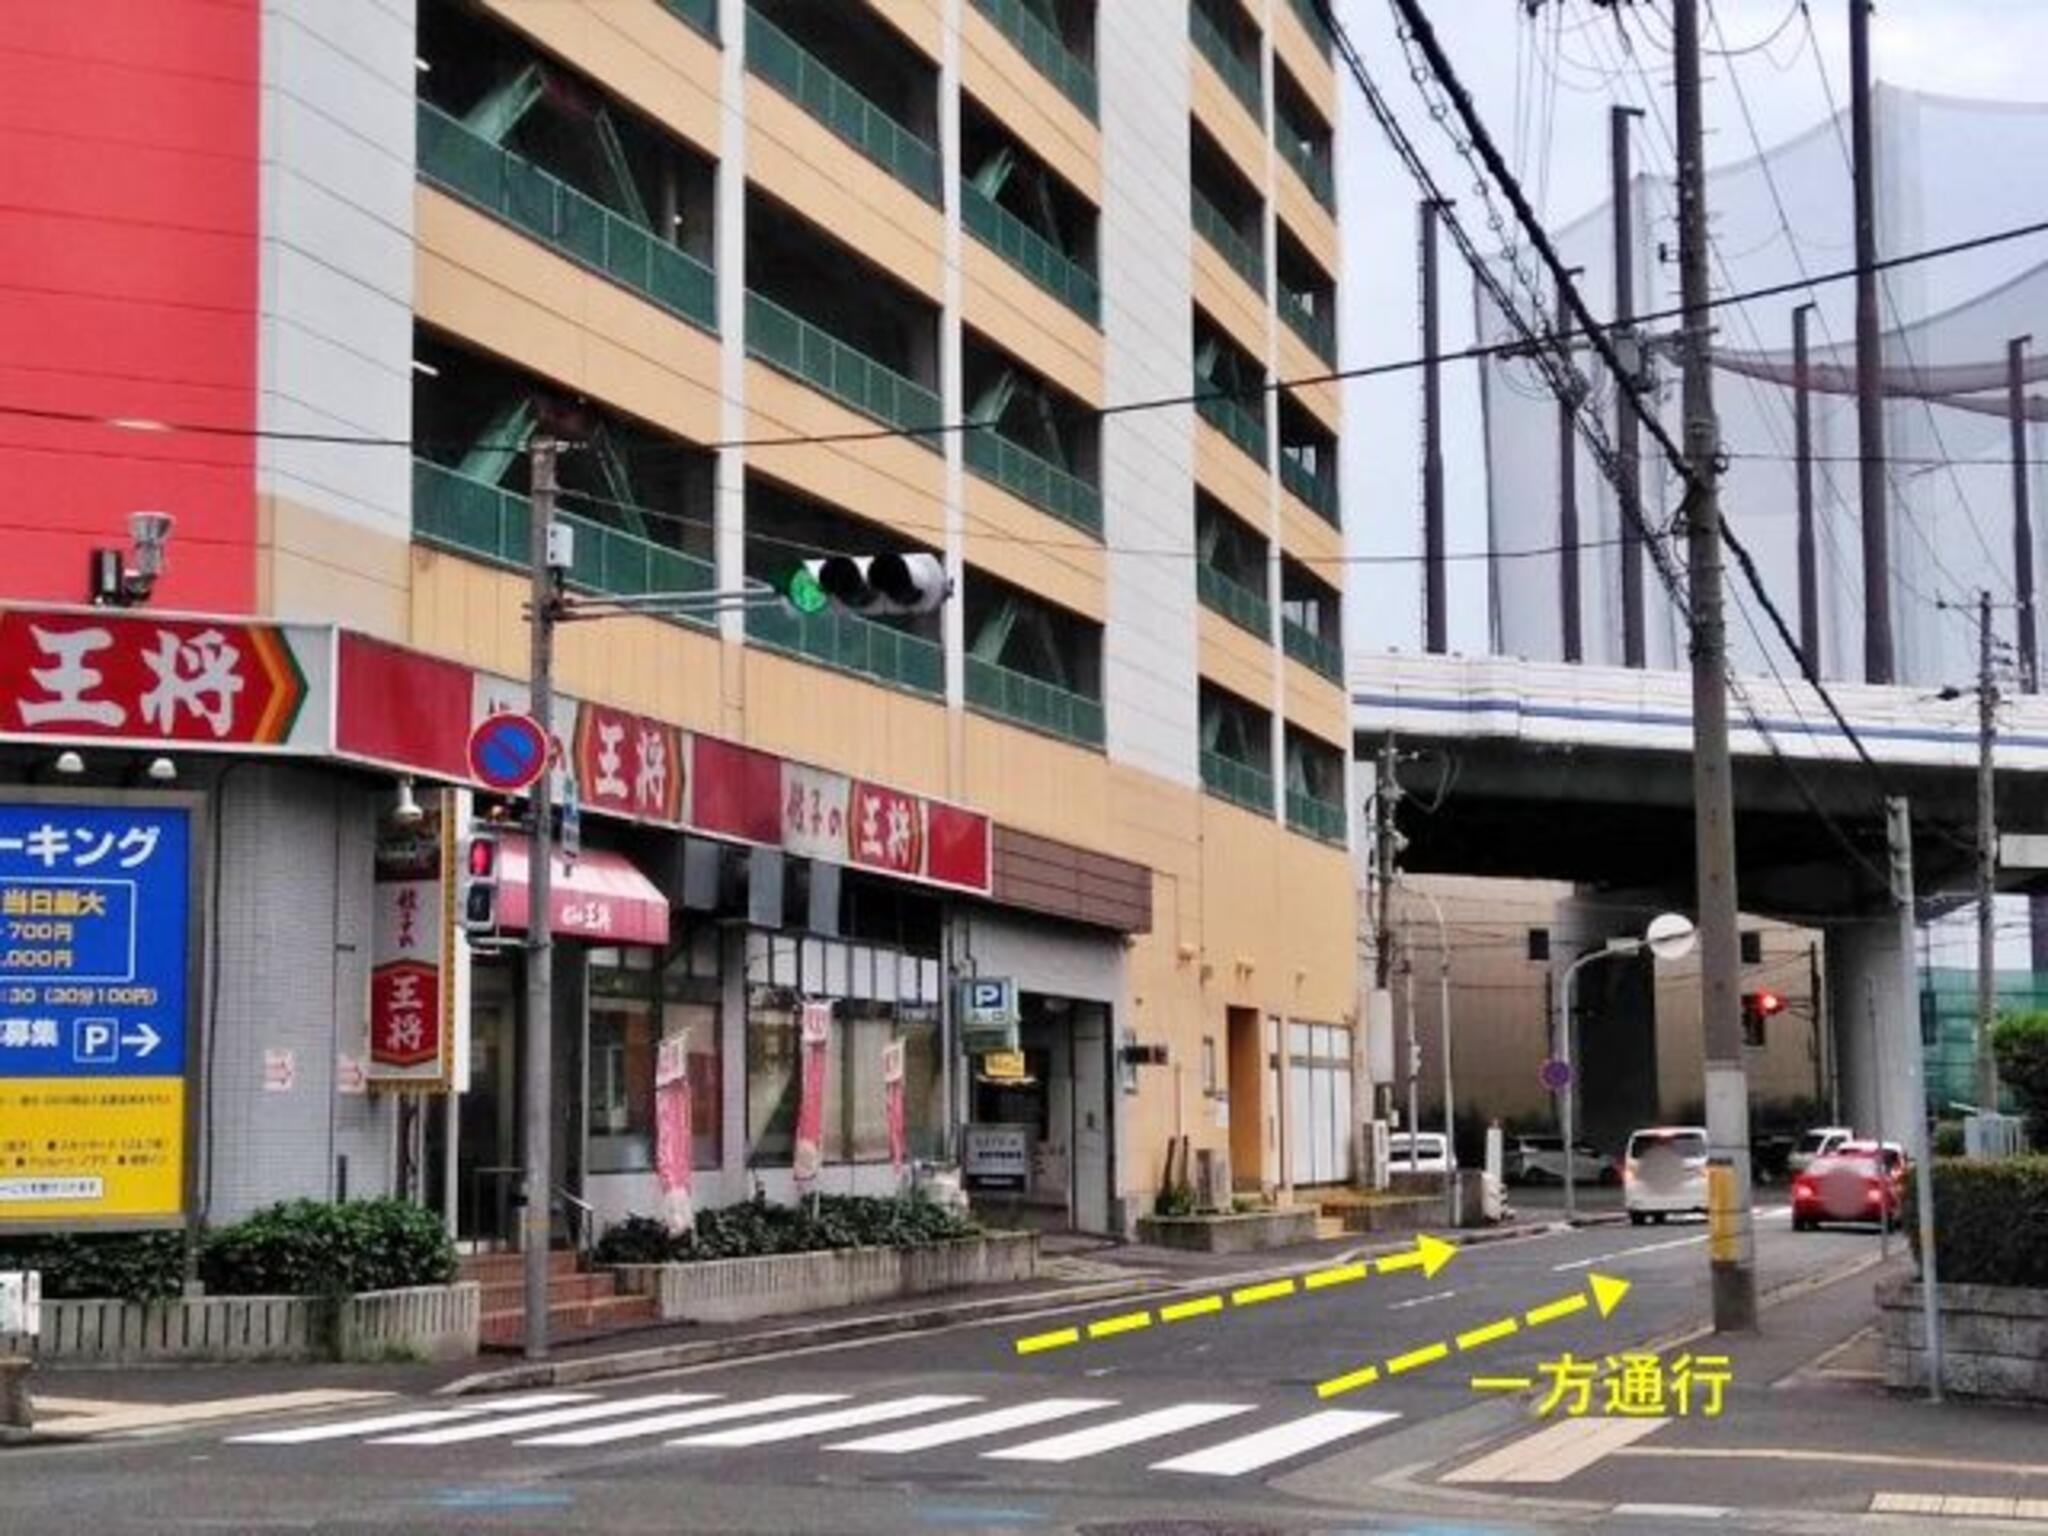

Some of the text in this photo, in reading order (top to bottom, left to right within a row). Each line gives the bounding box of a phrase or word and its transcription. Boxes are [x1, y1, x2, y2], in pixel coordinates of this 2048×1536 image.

[16, 622, 245, 738] 王将
[594, 717, 667, 812] 王将
[860, 790, 911, 867] 王将
[387, 974, 424, 1051] 王将
